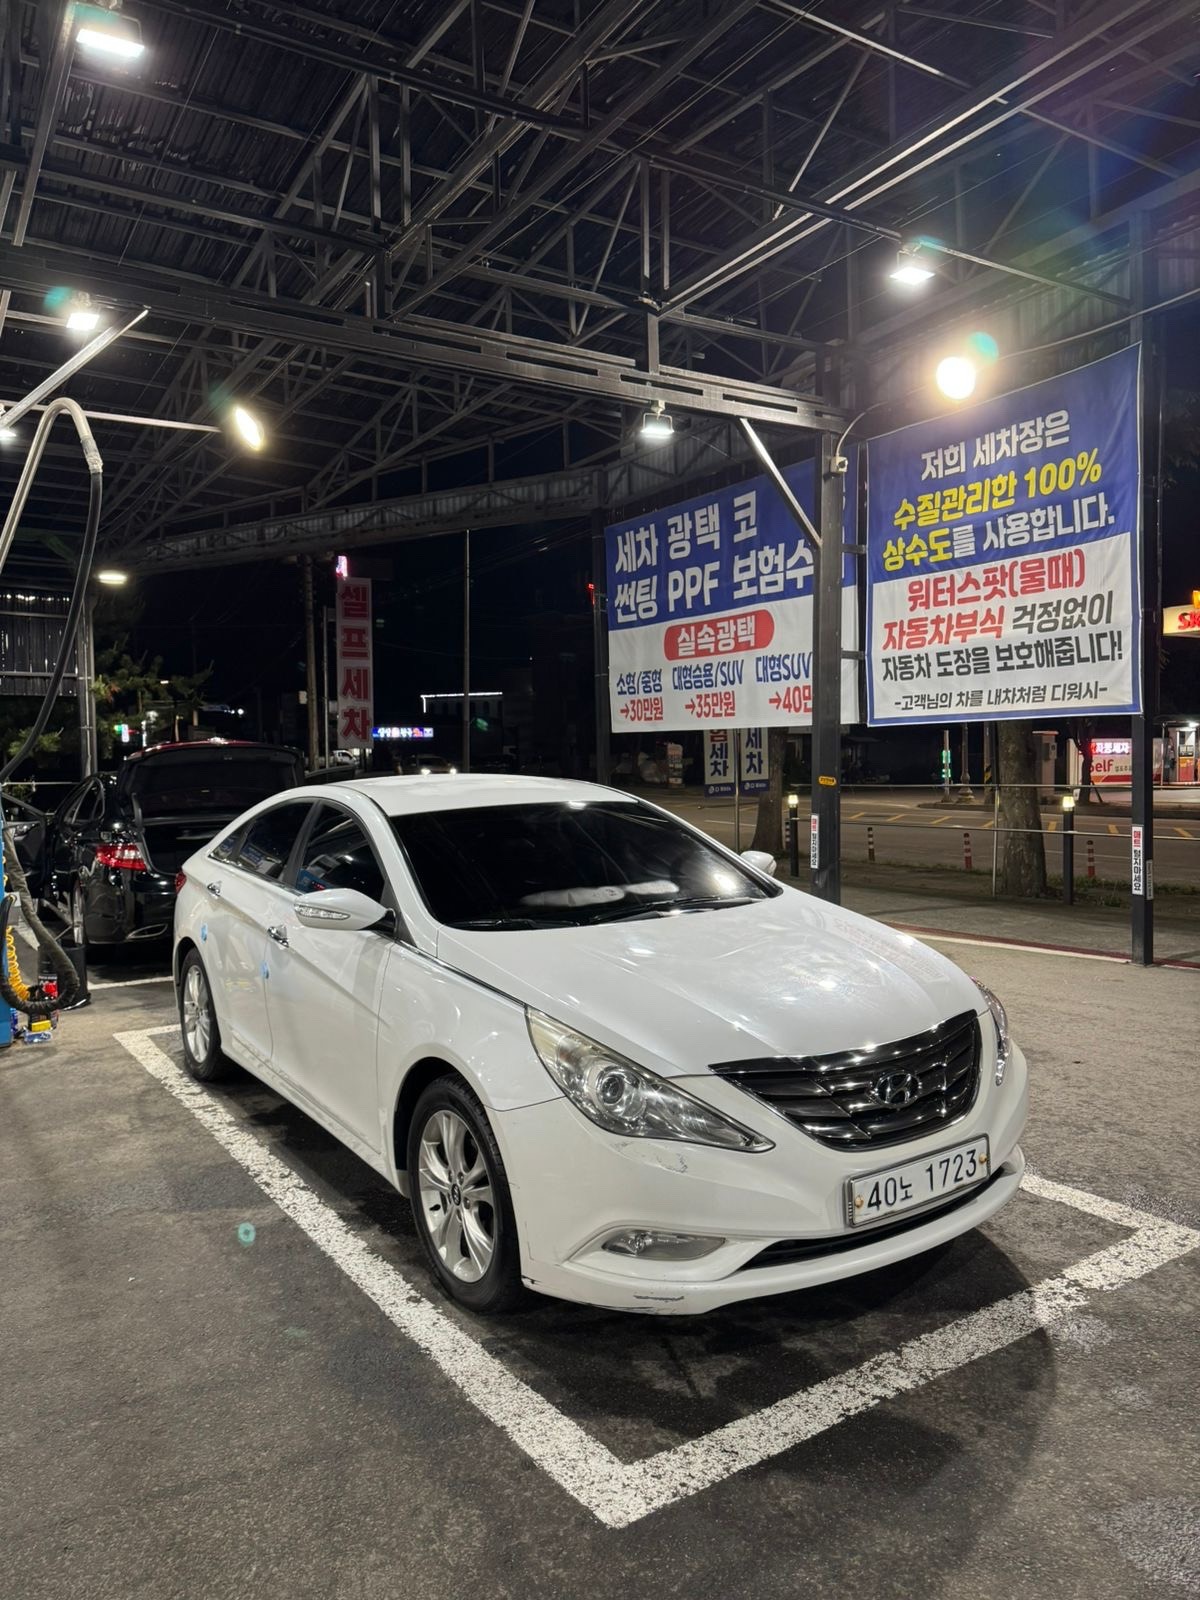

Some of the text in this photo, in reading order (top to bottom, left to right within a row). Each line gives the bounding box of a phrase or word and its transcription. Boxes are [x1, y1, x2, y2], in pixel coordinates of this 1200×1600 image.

[921, 409, 1070, 481] 저희 세차장은
[893, 447, 1102, 531] 수질관리한 100%
[615, 490, 757, 574] 세차 광택 코
[882, 492, 1115, 572] 상수도를 사용합니다.
[614, 539, 815, 624] 썬팅 PPF 보험수
[908, 548, 1085, 612] 워터스팟(물때)
[677, 615, 756, 657] 실속광택
[882, 590, 1114, 651] 자동차부식 걱정없이
[340, 585, 371, 742] 셀프세차
[616, 652, 813, 696] 소형/중형 대형승용/SUV 대형SUV
[881, 630, 1123, 682] 자동차 도장을 보호해줍니다!
[629, 696, 664, 722] 30만원
[695, 690, 736, 719] 35만원
[894, 692, 953, 711] -고객님의
[955, 690, 984, 708] 차를
[987, 685, 1047, 706] 내차처럼
[867, 1148, 978, 1212] 40노 1723
